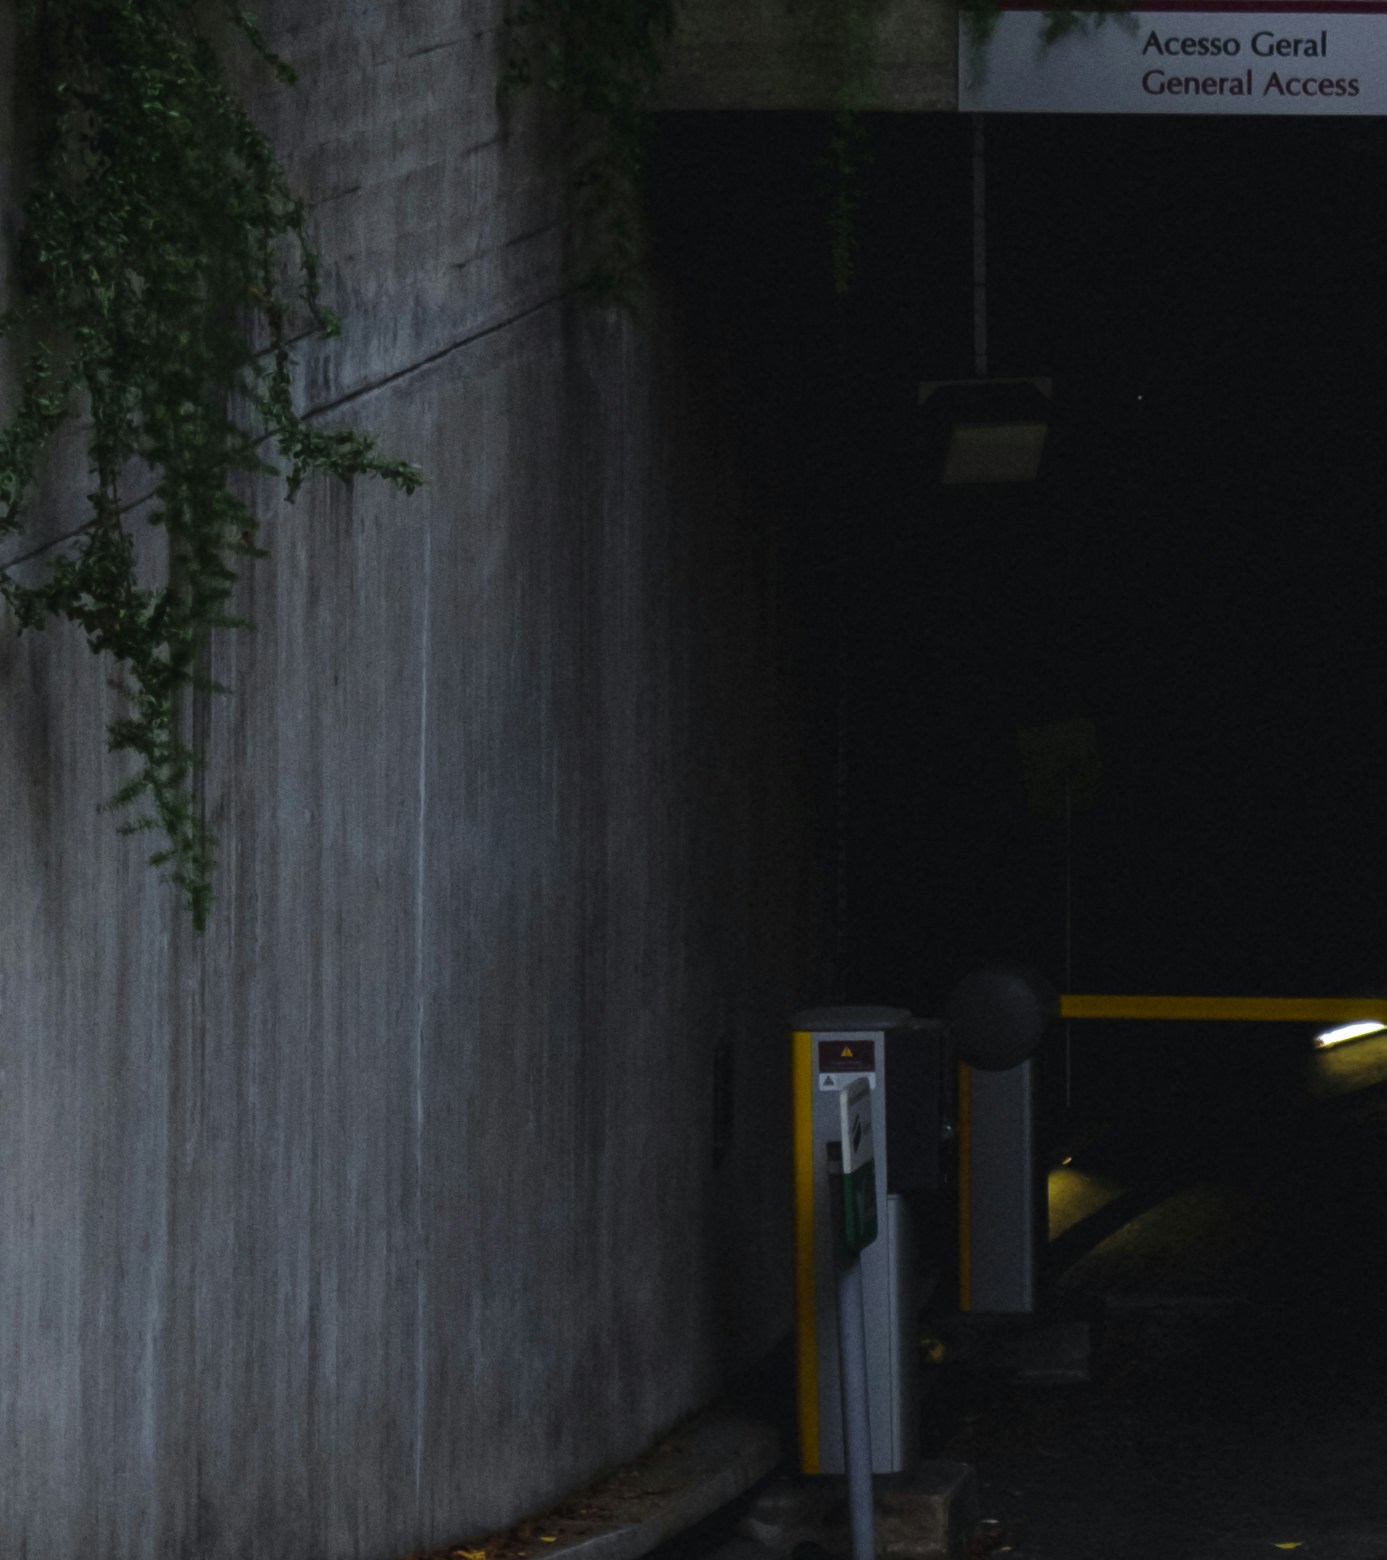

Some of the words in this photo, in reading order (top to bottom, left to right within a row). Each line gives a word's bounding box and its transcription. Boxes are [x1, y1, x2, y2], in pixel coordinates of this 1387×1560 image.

[1141, 30, 1241, 57] Acesso
[1250, 29, 1327, 58] Geral
[1141, 68, 1253, 97] General
[1263, 69, 1360, 97] Access
